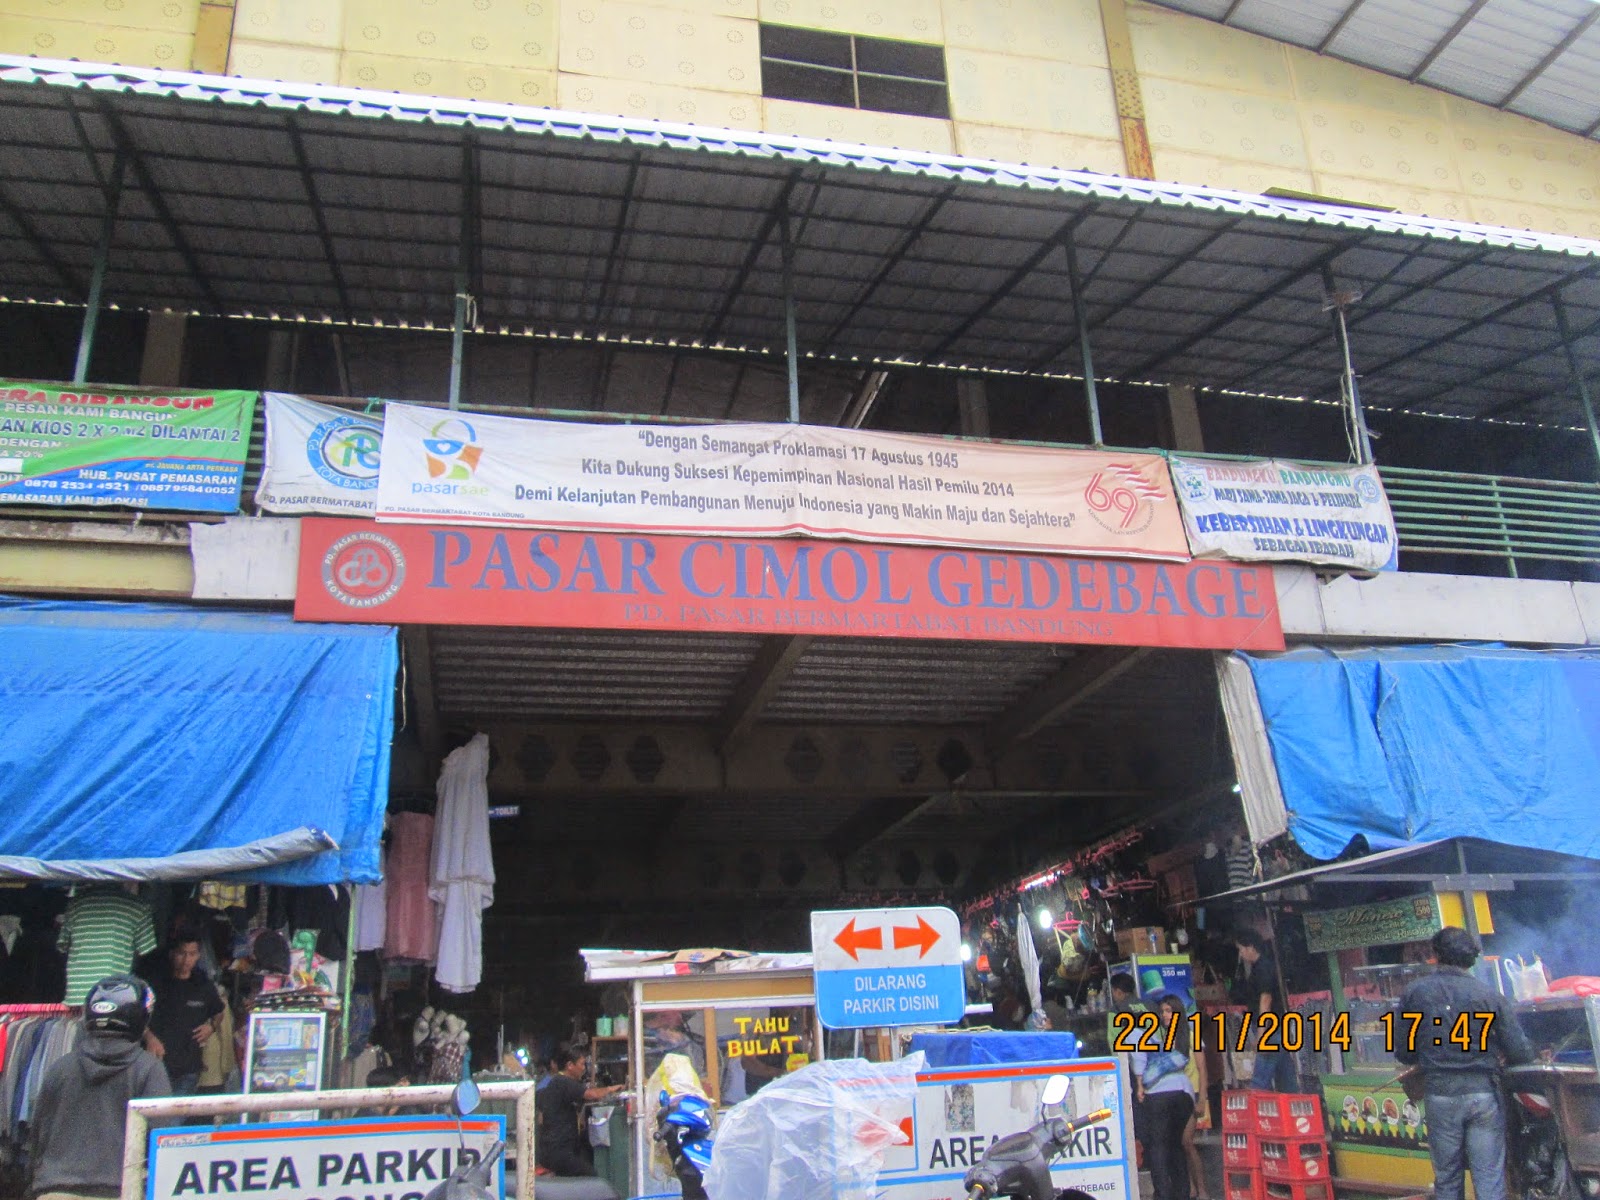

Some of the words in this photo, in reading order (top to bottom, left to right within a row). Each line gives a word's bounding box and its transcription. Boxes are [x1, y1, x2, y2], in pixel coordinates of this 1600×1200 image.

[5, 402, 58, 415] PESAN
[64, 405, 104, 417] KAMI
[31, 420, 72, 436] KIOS
[77, 423, 88, 437] 2
[151, 424, 226, 441] DILANTAI
[230, 429, 240, 442] 2
[702, 434, 769, 457] Semangat
[773, 440, 847, 460] Proklamasi
[852, 446, 866, 461] 17
[871, 449, 923, 467] Agustus
[927, 451, 959, 469] 1945
[79, 469, 111, 480] HUB.
[115, 471, 157, 482] PUSAT
[160, 473, 238, 485] PEMASARAN
[343, 479, 378, 489] BAND
[582, 458, 611, 475] Kita
[616, 460, 670, 482] Dukung
[674, 462, 728, 481] Suksesi
[733, 465, 832, 486] Kepemimpinan
[836, 470, 895, 490] Nasional
[898, 474, 932, 492] Hasil
[935, 478, 979, 495] Pemilu
[982, 481, 1014, 498] 2014
[1206, 467, 1278, 483] BANDUNGKU
[1279, 470, 1351, 487] BANDUNGMU
[65, 495, 94, 505] KAMI
[280, 496, 308, 505] PASAR
[310, 496, 373, 509] BERMATABAT
[515, 484, 552, 501] Demi
[557, 487, 636, 507] Kelanjutan
[641, 490, 740, 513] Pembangunan
[744, 494, 795, 514] Menuju
[799, 493, 863, 515] Indonesia
[867, 502, 899, 520] yang
[902, 502, 943, 521] Makin
[946, 504, 978, 525] Maju
[982, 506, 1006, 524] dan
[1084, 473, 1139, 528] 69
[1196, 512, 1293, 536] KEBERSIHAN
[1293, 518, 1304, 536] &
[1303, 518, 1389, 544] LINGKUNGAN
[1253, 537, 1308, 553] SEBAGAI
[1308, 540, 1355, 558] IBADAH
[425, 529, 667, 595] PASAR
[679, 540, 912, 605] CIMOL
[927, 552, 1265, 619] GEDEBAGE
[326, 580, 347, 602] KOTA
[350, 584, 398, 606] BANDUNG
[624, 603, 669, 623] PD.
[679, 604, 765, 626] PASAR
[775, 607, 976, 634] BERMARTABAT
[984, 616, 1113, 637] BANDUNG
[855, 973, 927, 992] DILARANG
[843, 997, 896, 1014] PARKIR
[899, 994, 939, 1012] DISINI
[733, 1016, 789, 1035] TAHU
[727, 1035, 800, 1058] BULAT
[929, 1135, 1000, 1169] ARE
[171, 1156, 301, 1197] AREA
